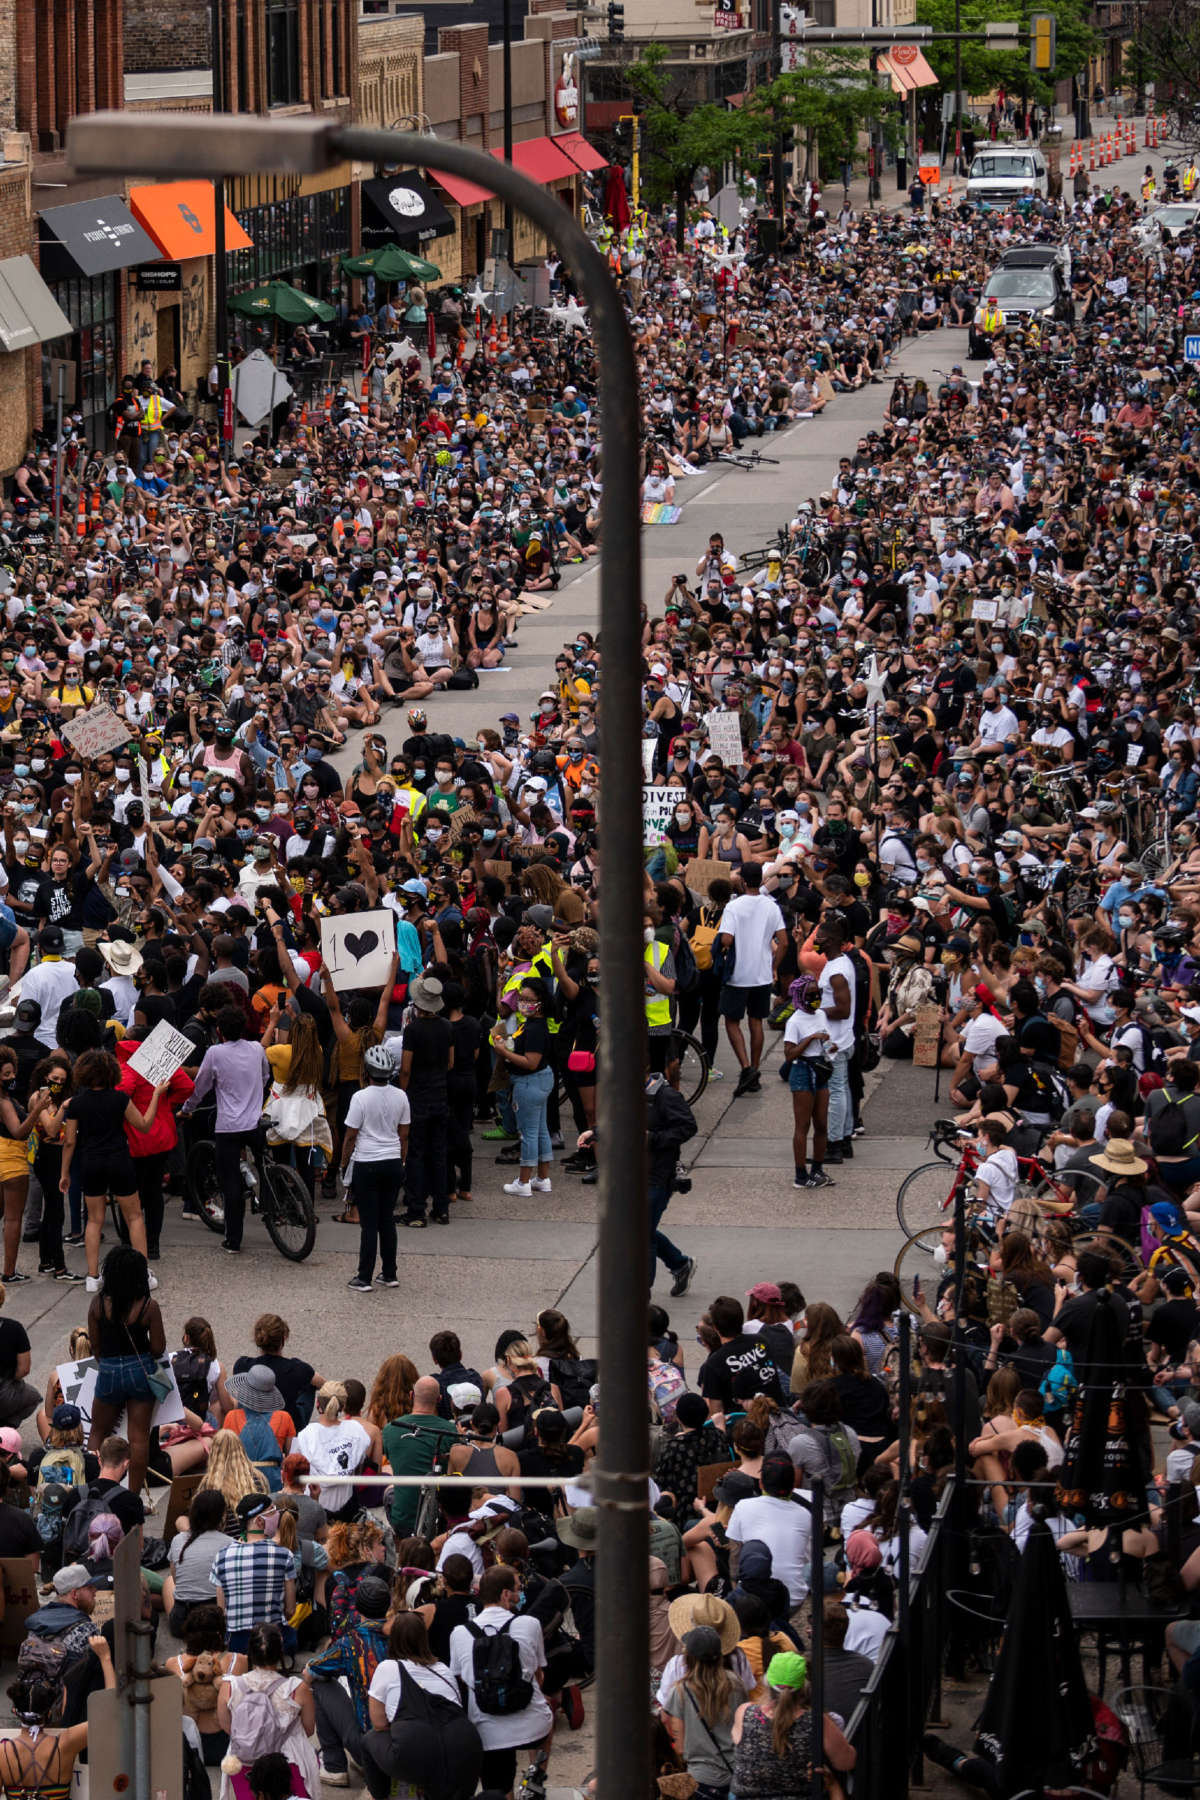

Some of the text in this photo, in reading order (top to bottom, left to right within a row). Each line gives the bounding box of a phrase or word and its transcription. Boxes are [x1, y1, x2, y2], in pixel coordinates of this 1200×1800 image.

[642, 791, 685, 804] DIVEST
[163, 1030, 194, 1063] MATTER
[726, 1345, 767, 1372] Save
